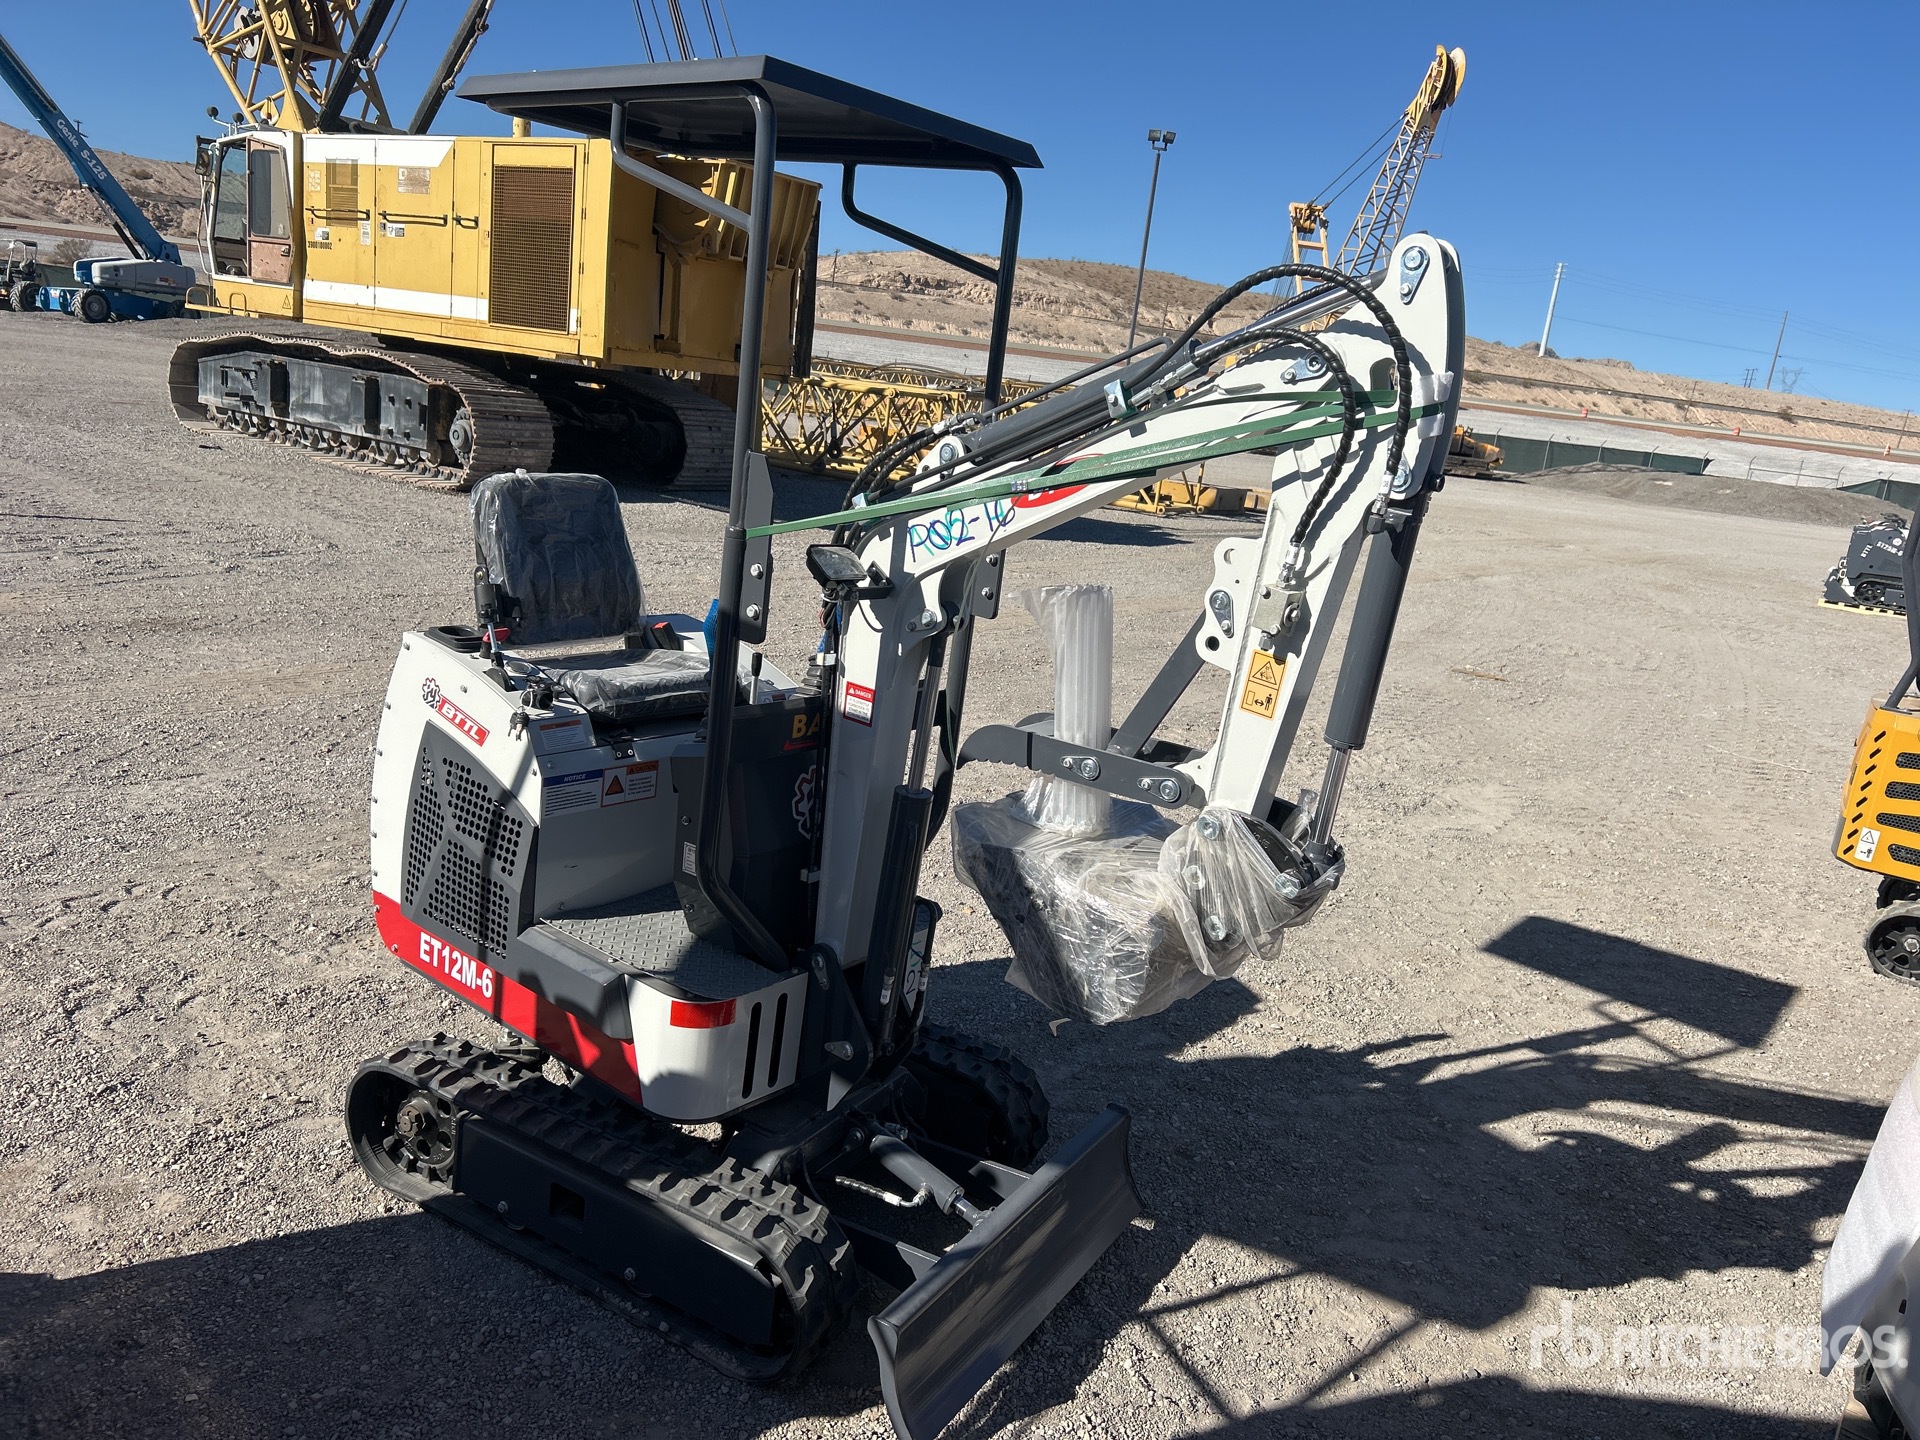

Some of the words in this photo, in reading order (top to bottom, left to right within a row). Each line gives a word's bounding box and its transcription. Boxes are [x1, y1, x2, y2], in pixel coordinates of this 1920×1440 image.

[57, 119, 79, 148] Genie
[81, 149, 107, 180] S-125
[855, 689, 872, 699] DANGER
[440, 703, 480, 740] BTTL
[563, 773, 587, 782] NOTICE
[420, 931, 493, 999] ET12M-6
